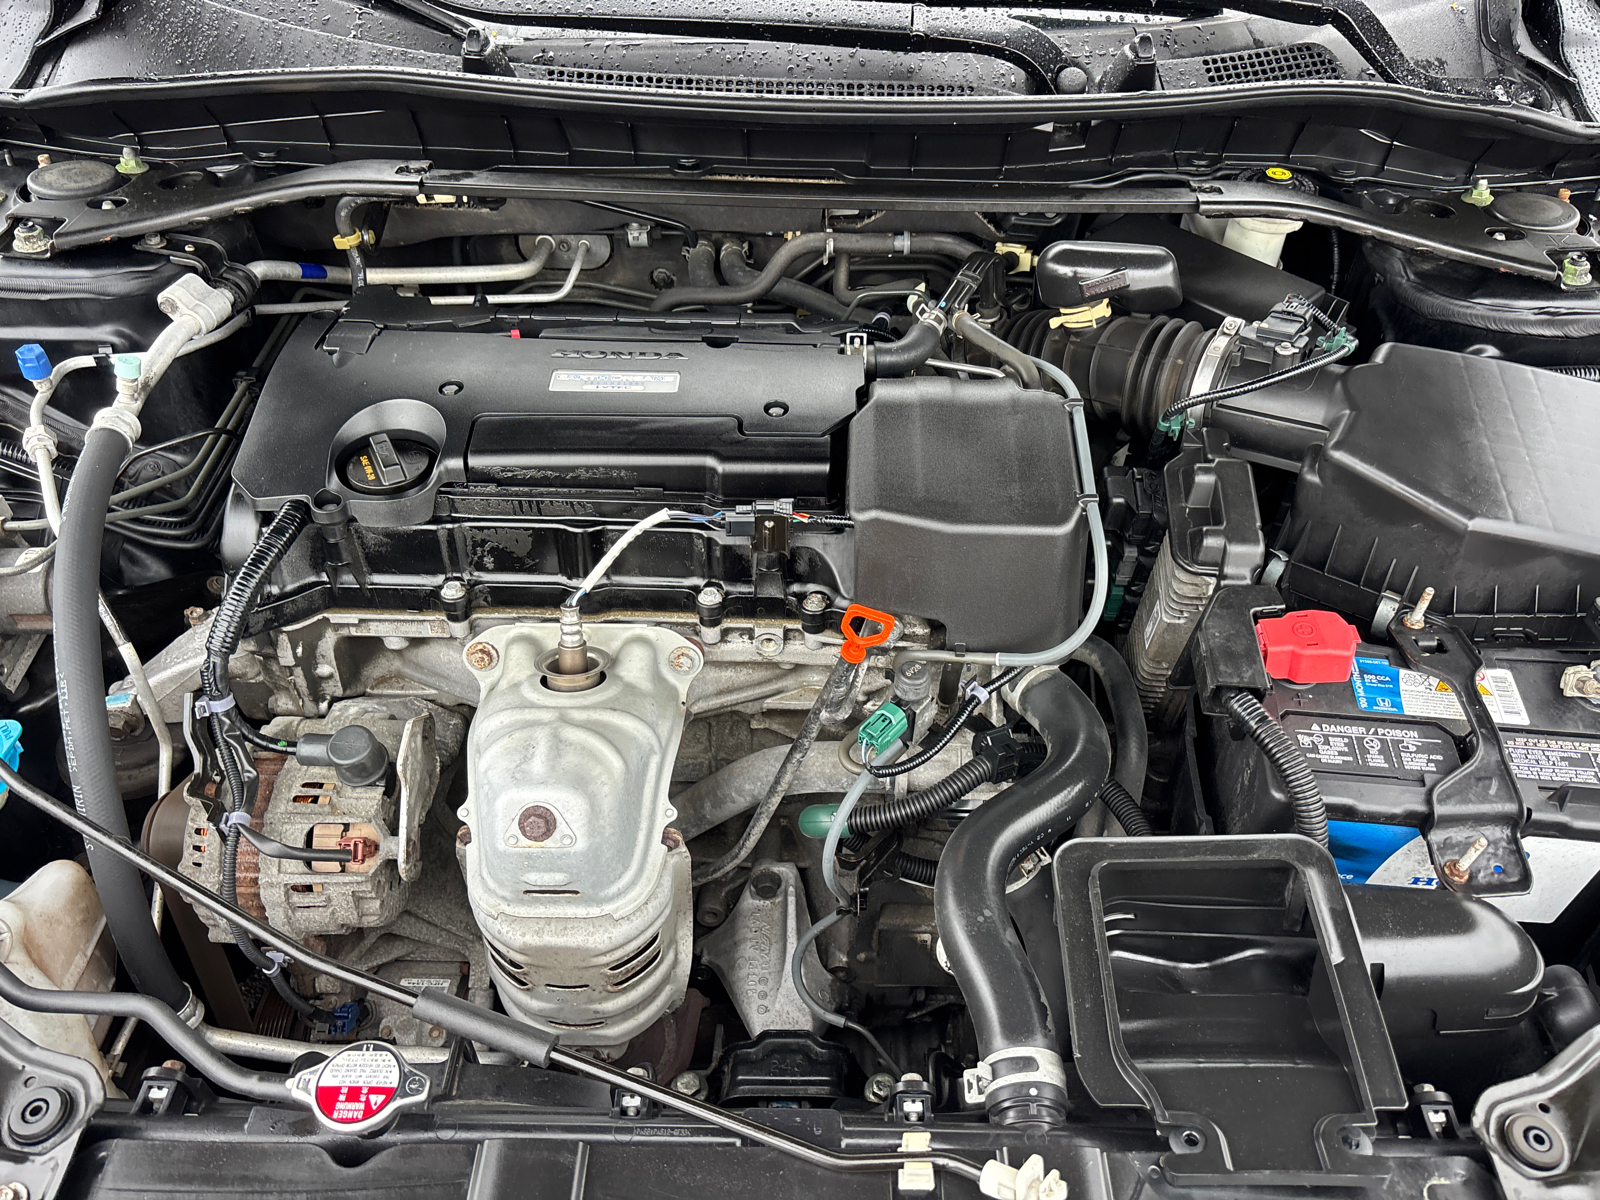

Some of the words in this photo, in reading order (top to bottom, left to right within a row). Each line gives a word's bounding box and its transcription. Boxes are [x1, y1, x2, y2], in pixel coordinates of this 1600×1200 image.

[551, 349, 689, 360] HONDA
[557, 374, 609, 382] EARTH
[611, 374, 676, 383] DREAMS
[360, 455, 371, 467] SAE
[1359, 697, 1369, 709] 100
[1322, 724, 1366, 734] DANGER
[1378, 728, 1418, 738] POISON
[1544, 750, 1581, 758] IMMEDIATELY
[335, 1102, 365, 1110] WARNUNG
[332, 1110, 364, 1118] DANGER
